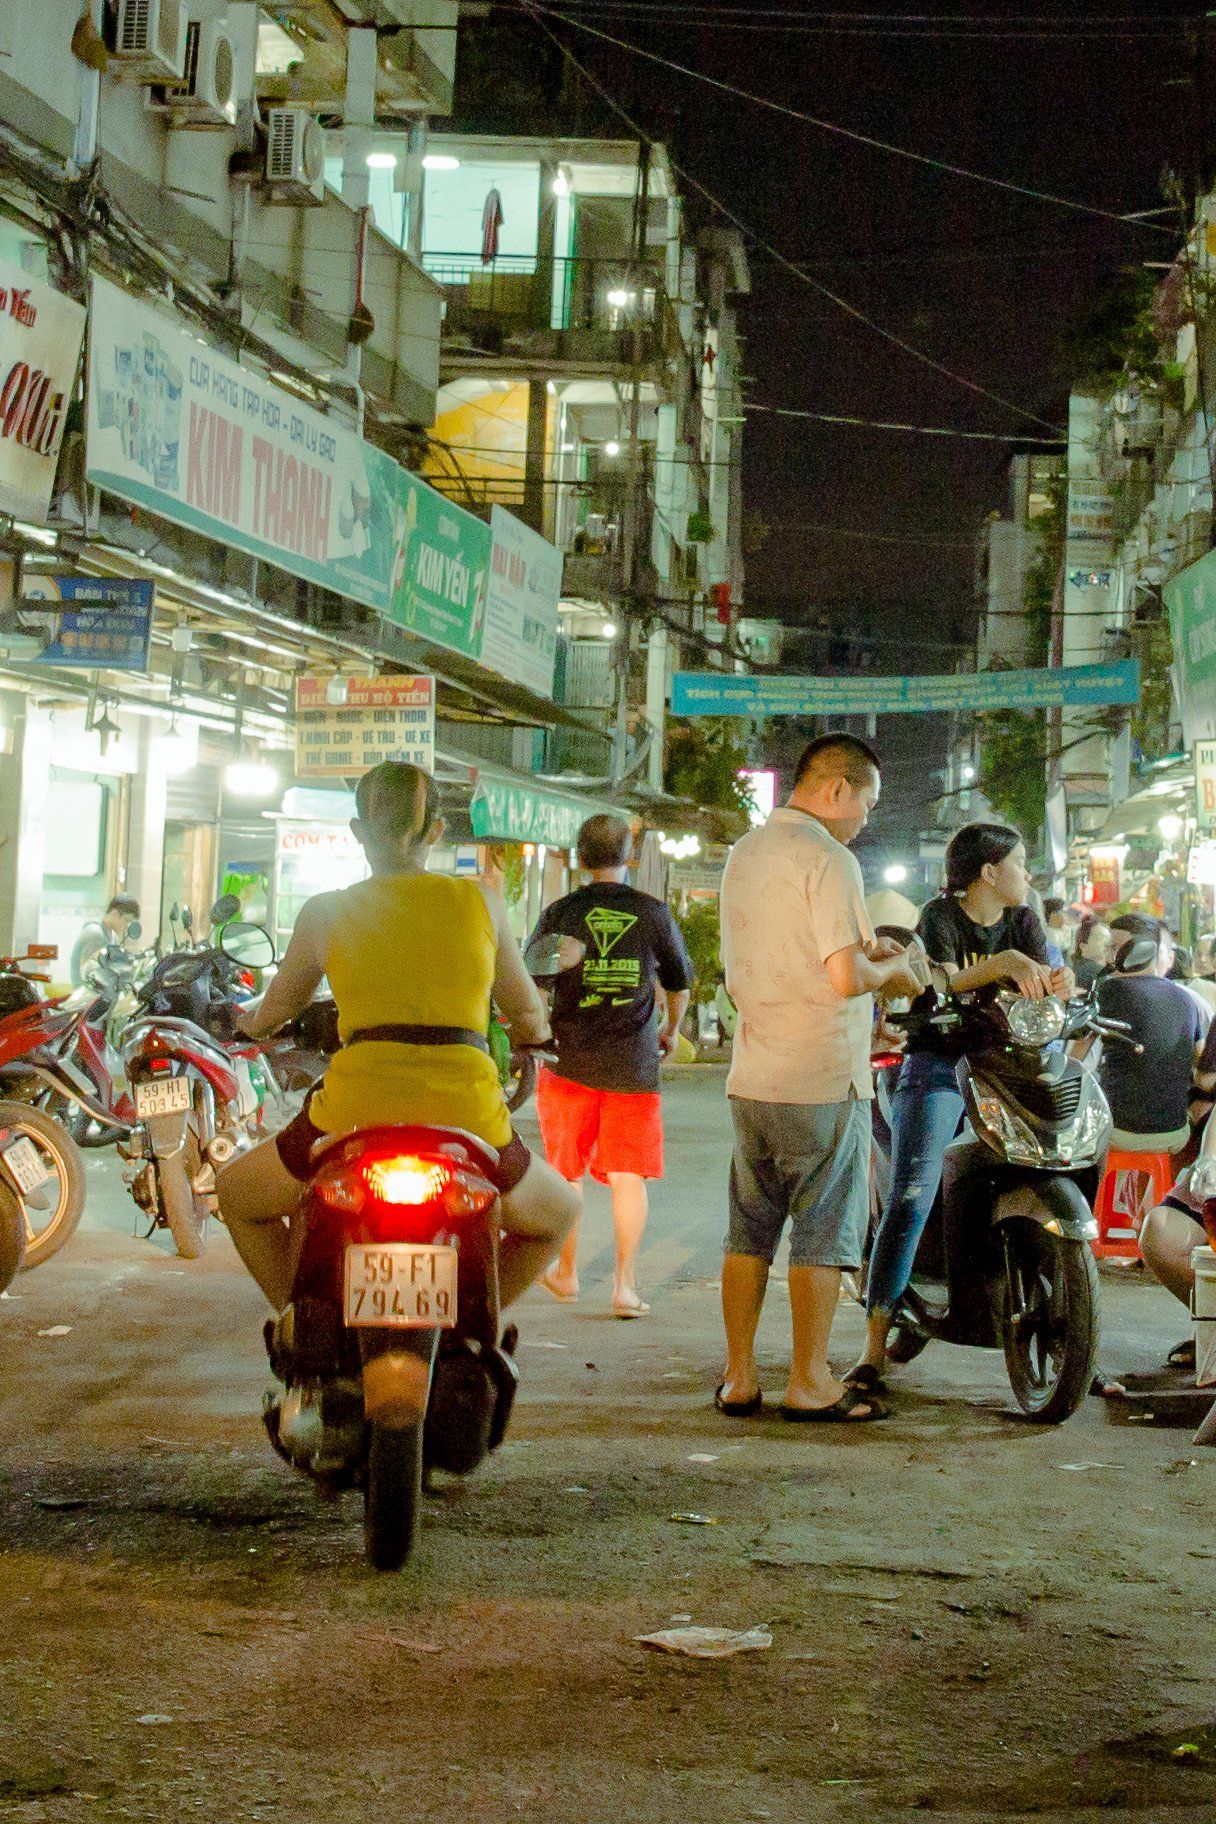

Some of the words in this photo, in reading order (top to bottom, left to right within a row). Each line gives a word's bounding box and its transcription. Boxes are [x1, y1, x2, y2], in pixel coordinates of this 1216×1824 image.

[187, 400, 244, 526] KIM
[417, 542, 444, 596] KIM
[364, 1250, 436, 1284] 59-F1
